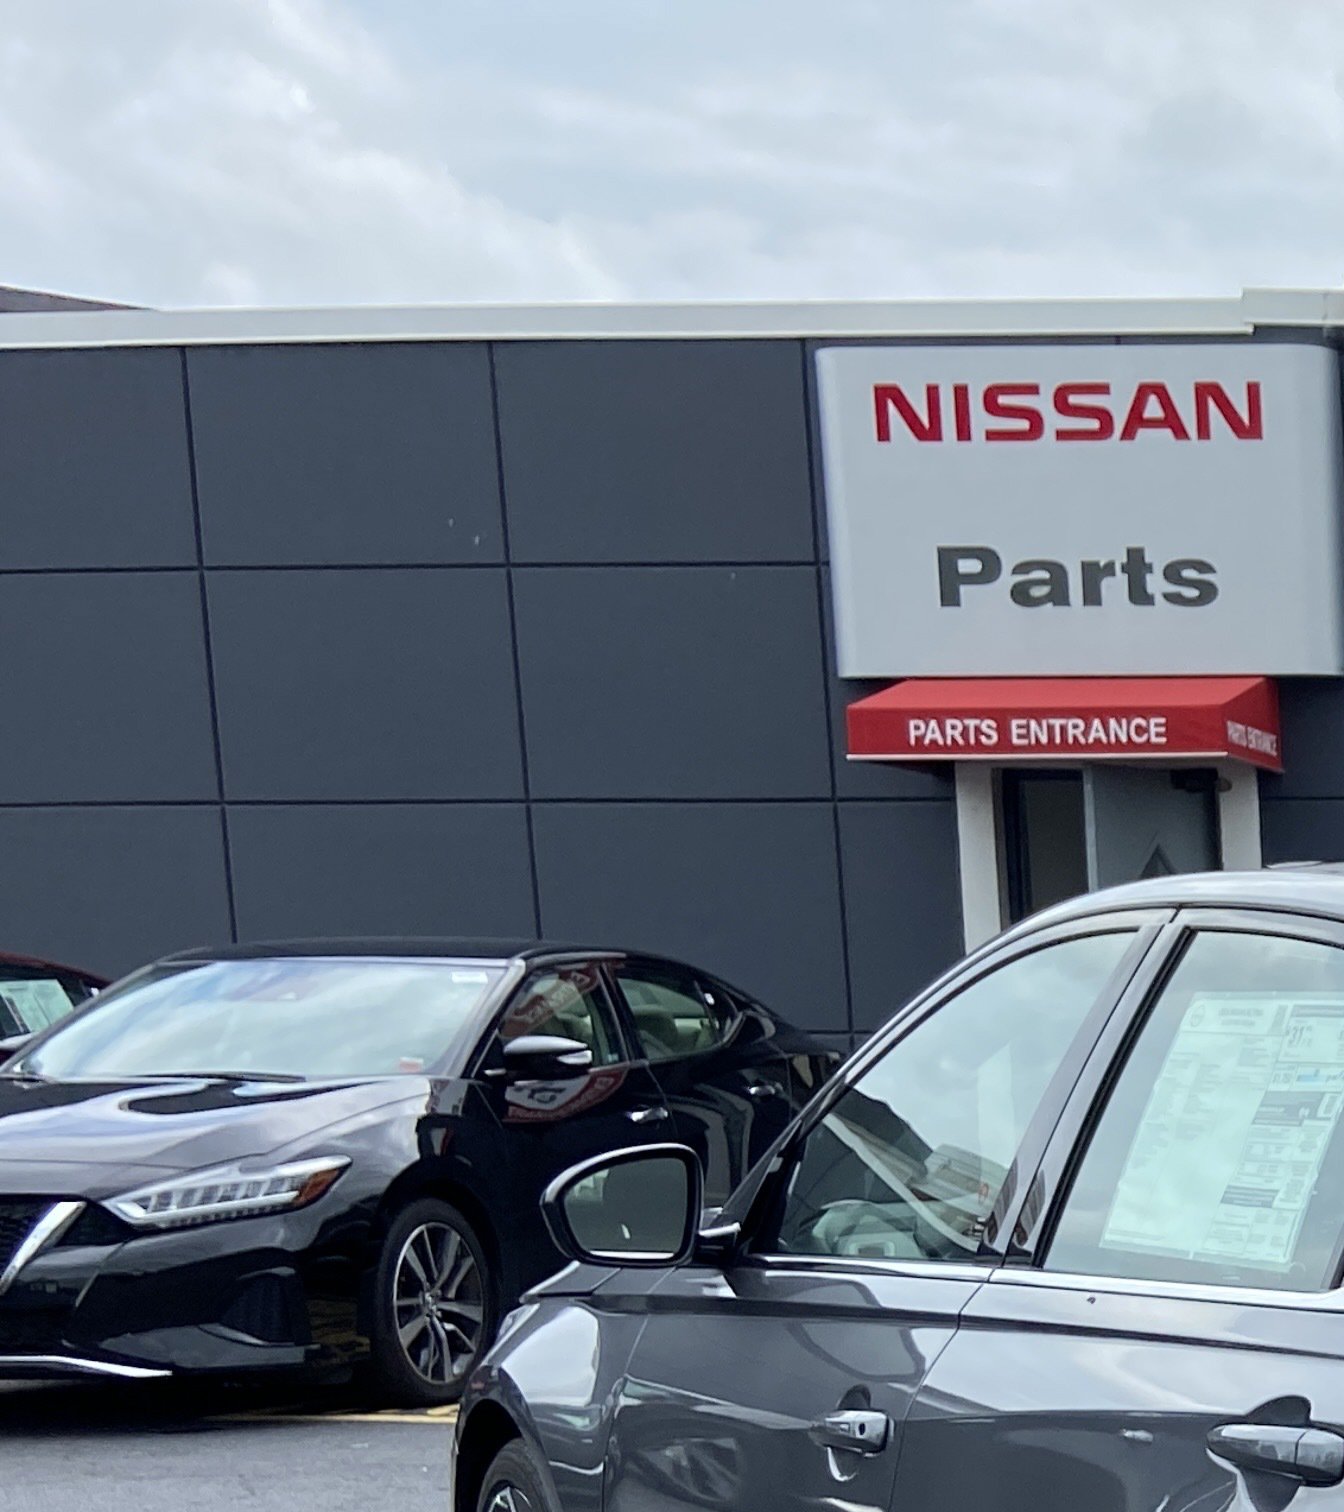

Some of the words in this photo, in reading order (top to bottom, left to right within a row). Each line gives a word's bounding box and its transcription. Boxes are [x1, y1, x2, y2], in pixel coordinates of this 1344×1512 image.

[872, 381, 1264, 442] NISSAN
[936, 546, 1220, 608] Parts
[908, 718, 999, 746] PARTS
[1010, 717, 1168, 745] ENTRANCE
